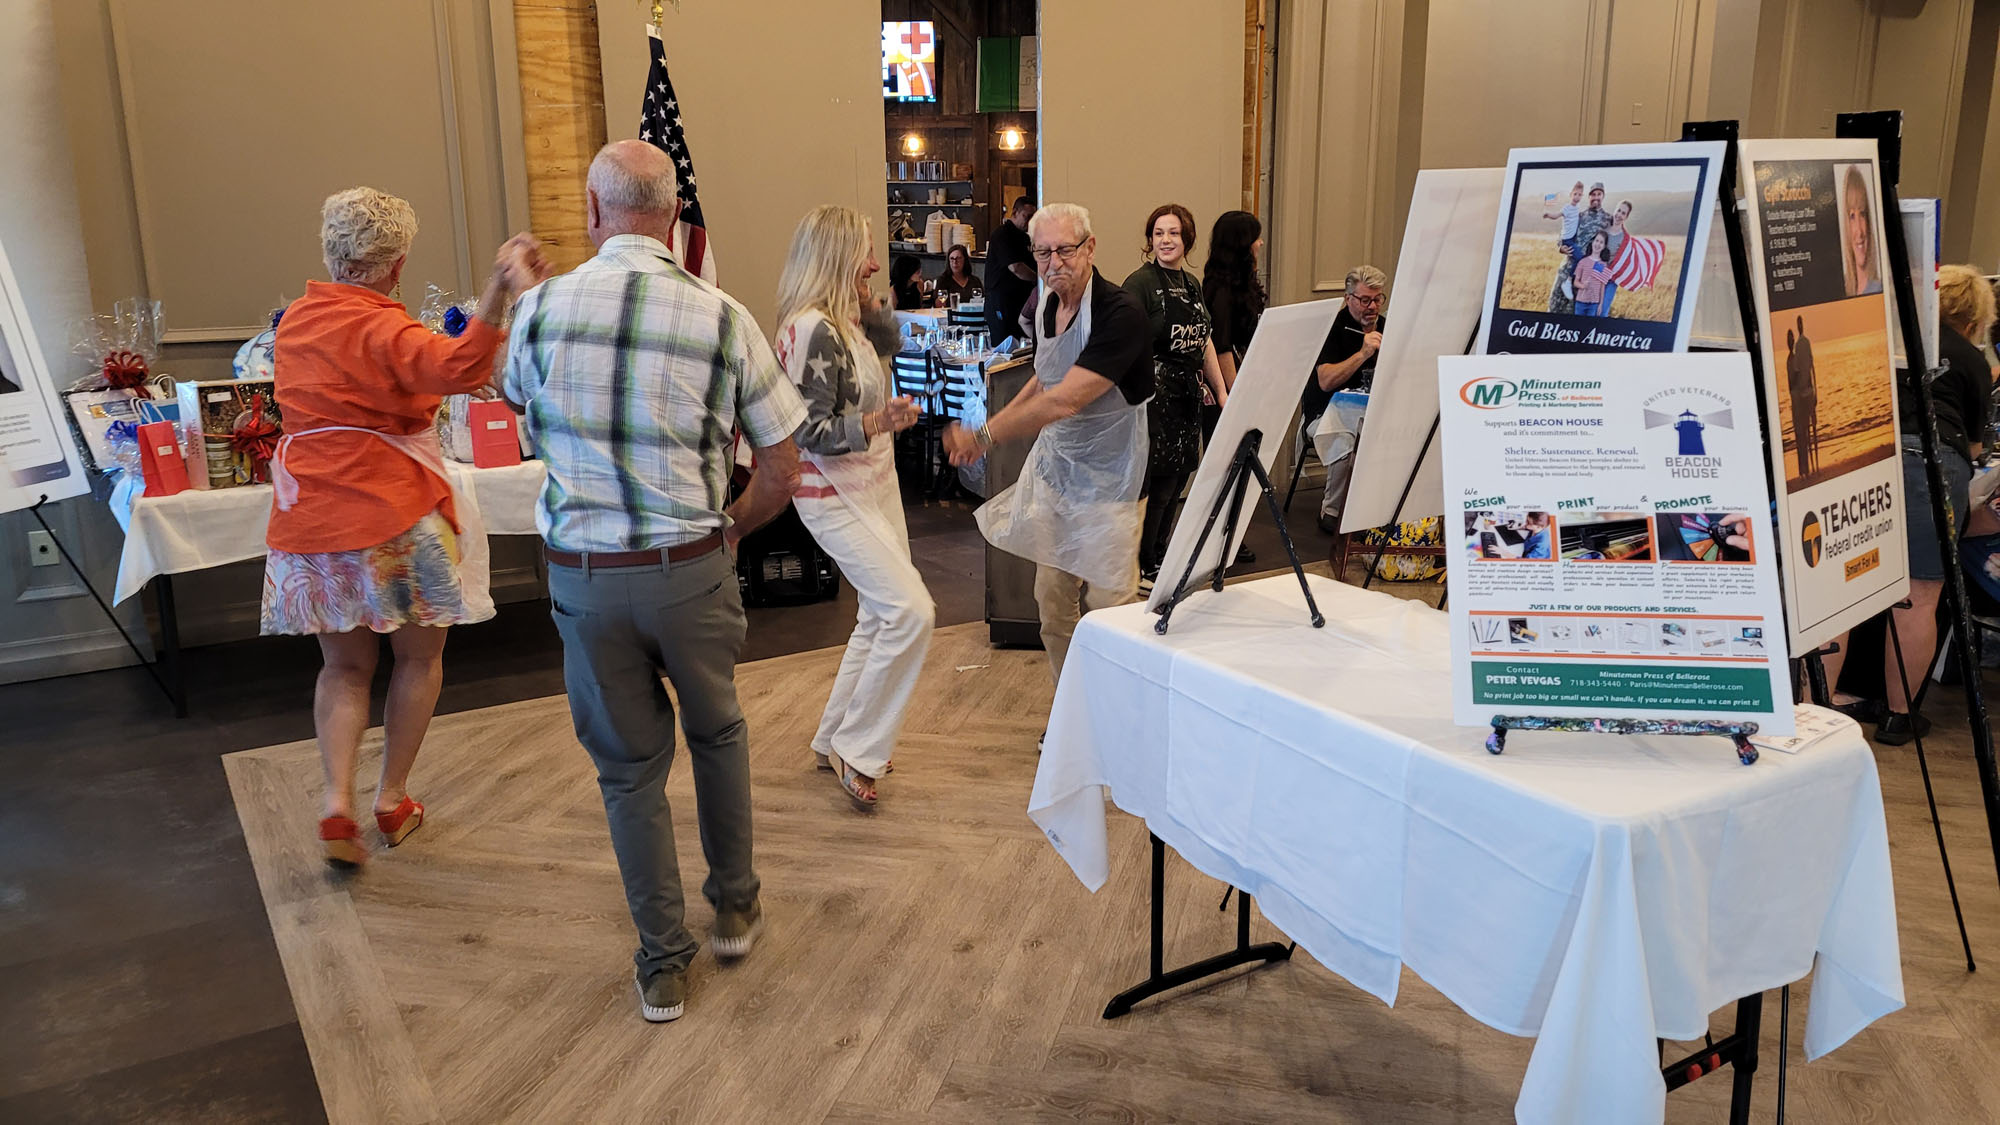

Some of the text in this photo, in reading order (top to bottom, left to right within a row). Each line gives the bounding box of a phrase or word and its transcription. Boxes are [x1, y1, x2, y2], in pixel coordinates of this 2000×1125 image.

[1508, 320, 1652, 350] God Bless America
[1521, 379, 1601, 389] Minuteman
[1643, 387, 1731, 406] UNITED VETERANS
[1484, 420, 1517, 428] Supports
[1665, 457, 1721, 467] BEACON
[1672, 468, 1719, 478] HOUSE
[1464, 496, 1506, 509] DESIGN
[1557, 497, 1594, 510] PRINT
[1655, 495, 1712, 511] PROMOTE
[1821, 482, 1892, 536] TEACHERS
[1825, 518, 1893, 560] federal credit union
[1846, 561, 1861, 576] Smart
[1862, 556, 1871, 568] For
[1486, 675, 1561, 685] PETER VEVGAS
[1630, 682, 1743, 690] Paris@MinutemanBellerose.com
